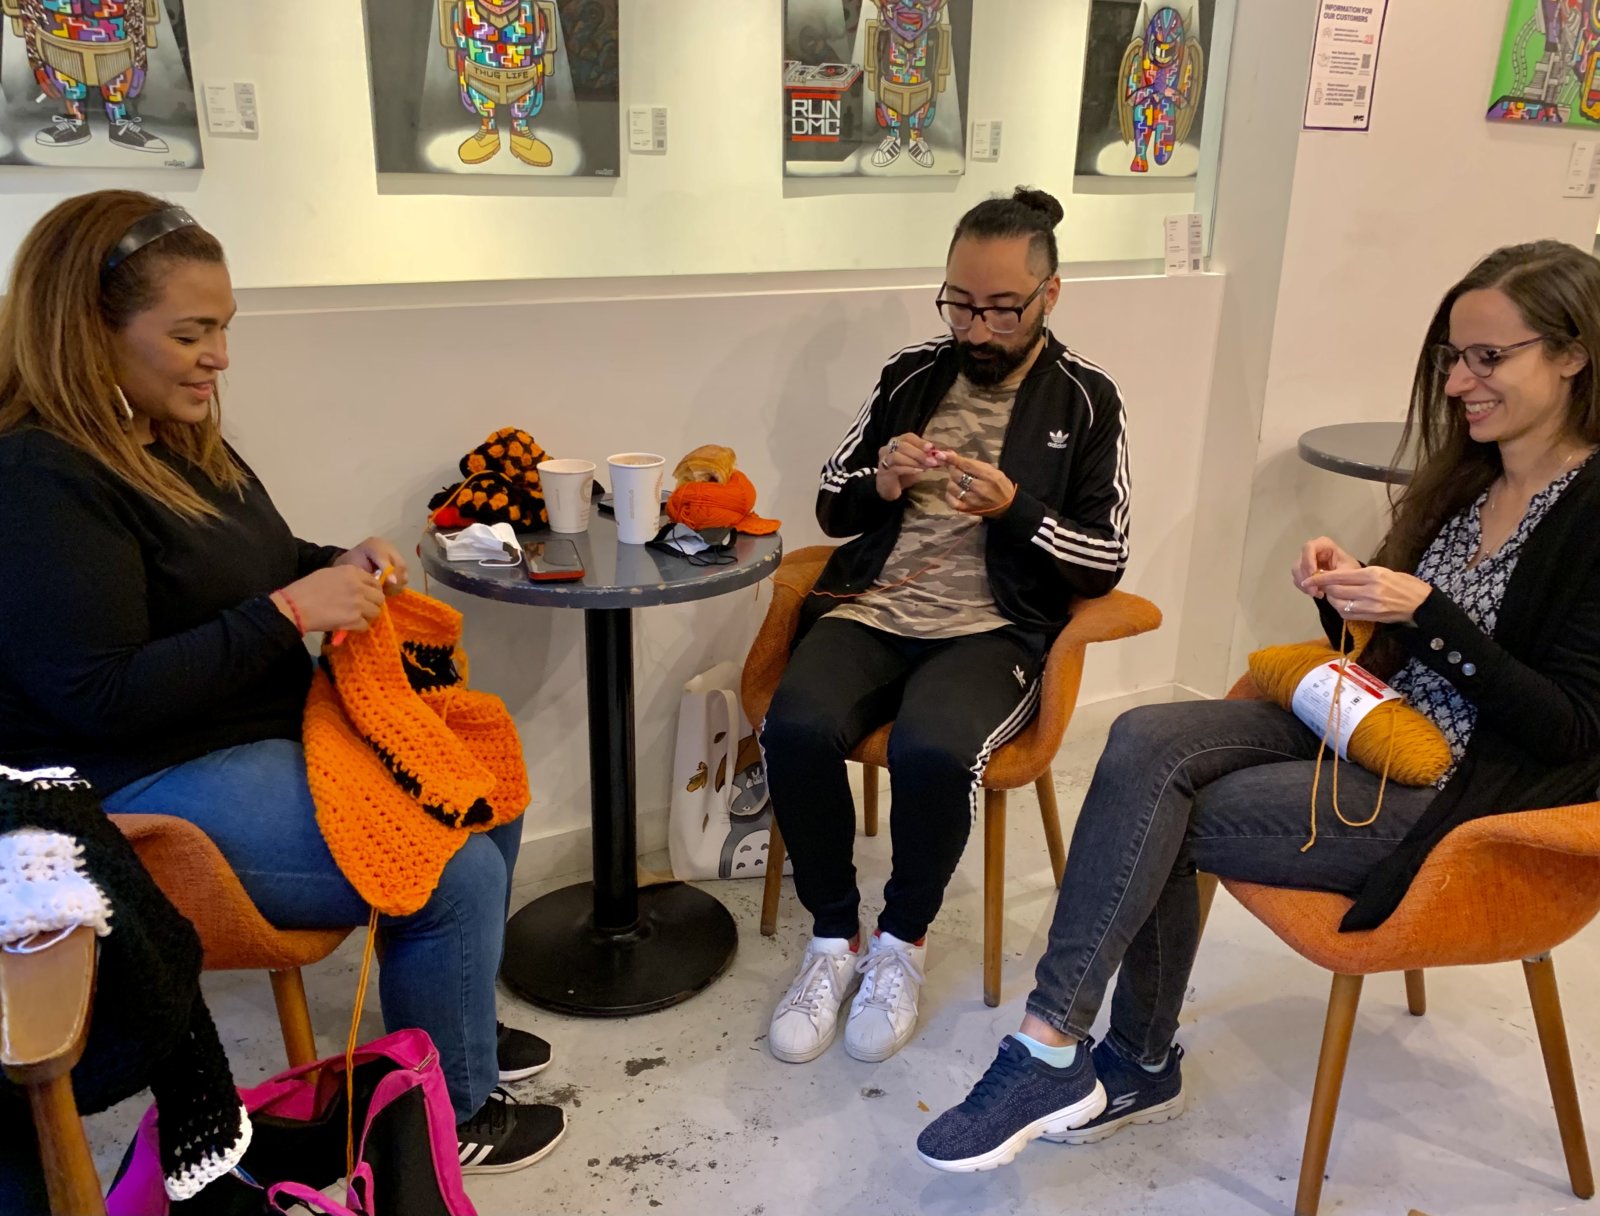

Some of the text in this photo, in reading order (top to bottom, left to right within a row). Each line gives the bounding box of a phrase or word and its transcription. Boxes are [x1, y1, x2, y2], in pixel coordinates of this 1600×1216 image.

[1325, 4, 1361, 13] INFORMATION
[1335, 14, 1368, 22] CUSTOMERS
[474, 67, 528, 79] THUG LIFE
[792, 99, 840, 118] RUN
[792, 118, 840, 135] DMC
